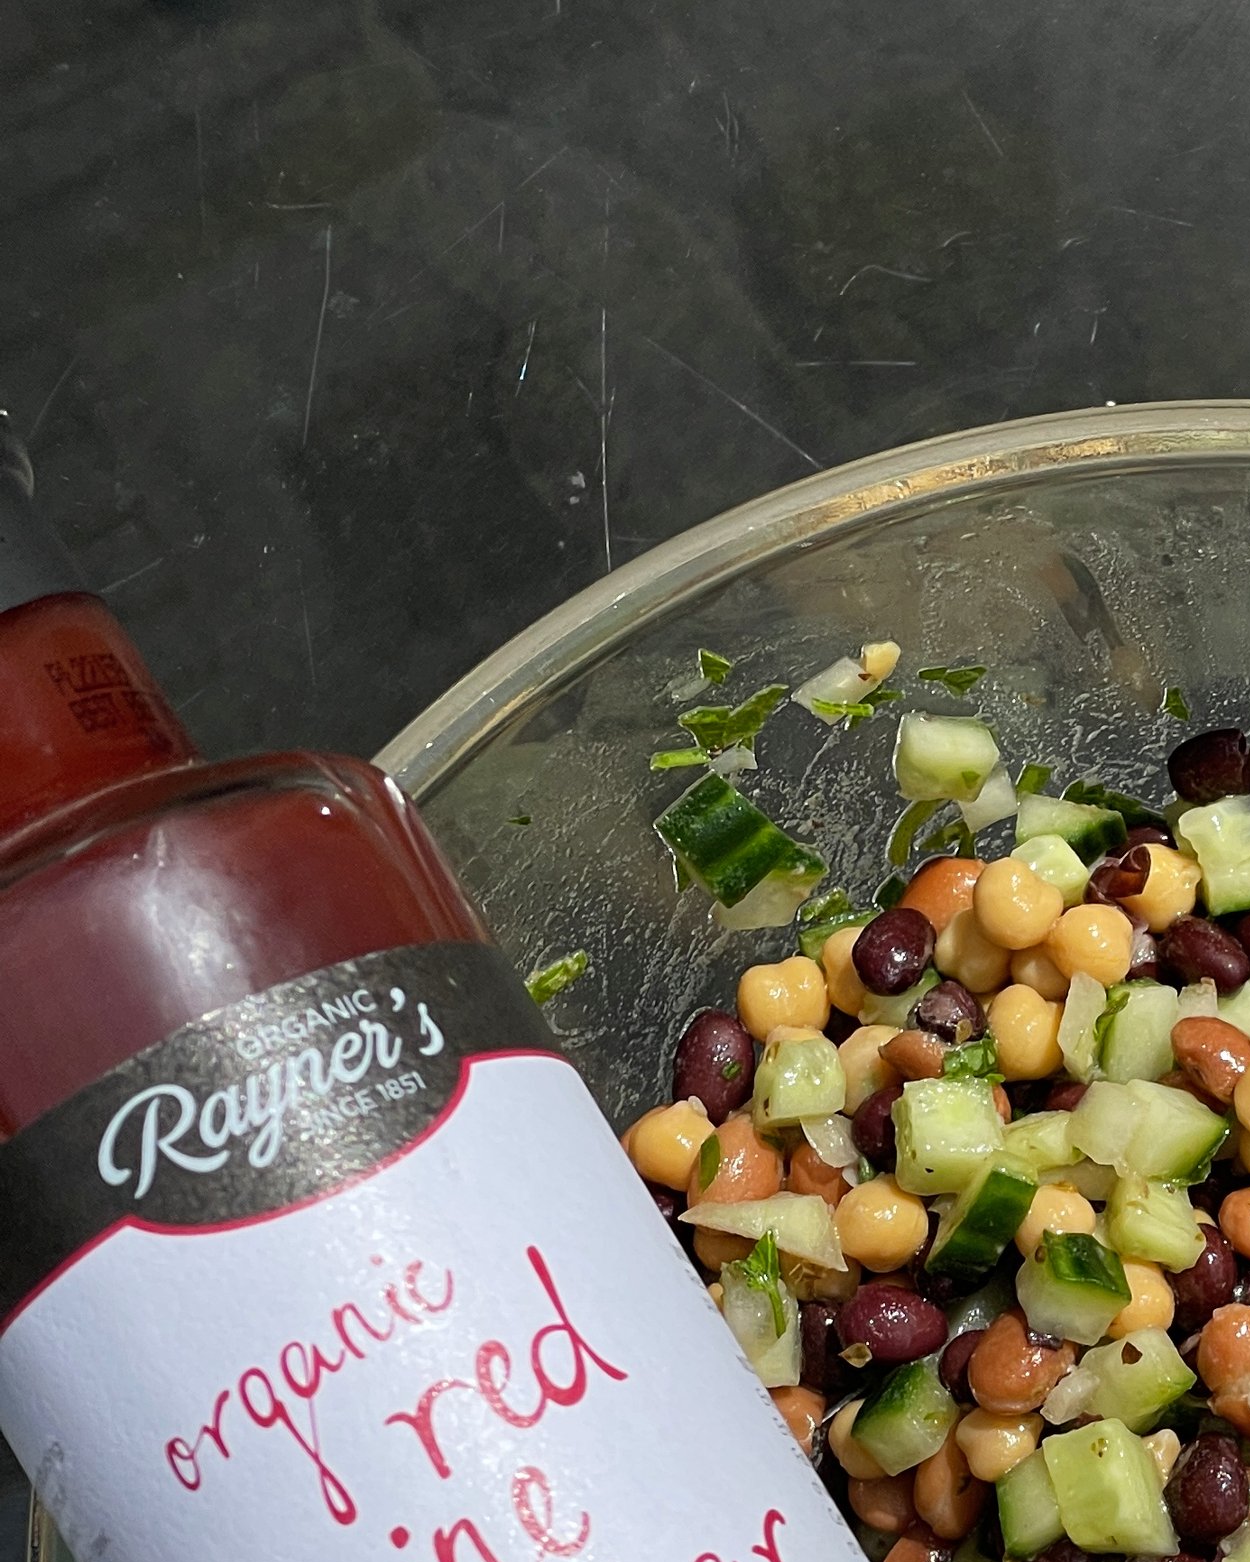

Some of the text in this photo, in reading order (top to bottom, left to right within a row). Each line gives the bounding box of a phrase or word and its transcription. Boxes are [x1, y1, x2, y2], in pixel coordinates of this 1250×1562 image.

[98, 986, 445, 1199] Rayner's
[236, 988, 377, 1060] ORGANIC
[375, 1071, 427, 1102] 1851
[165, 1254, 453, 1526] organic
[385, 1246, 627, 1479] red
